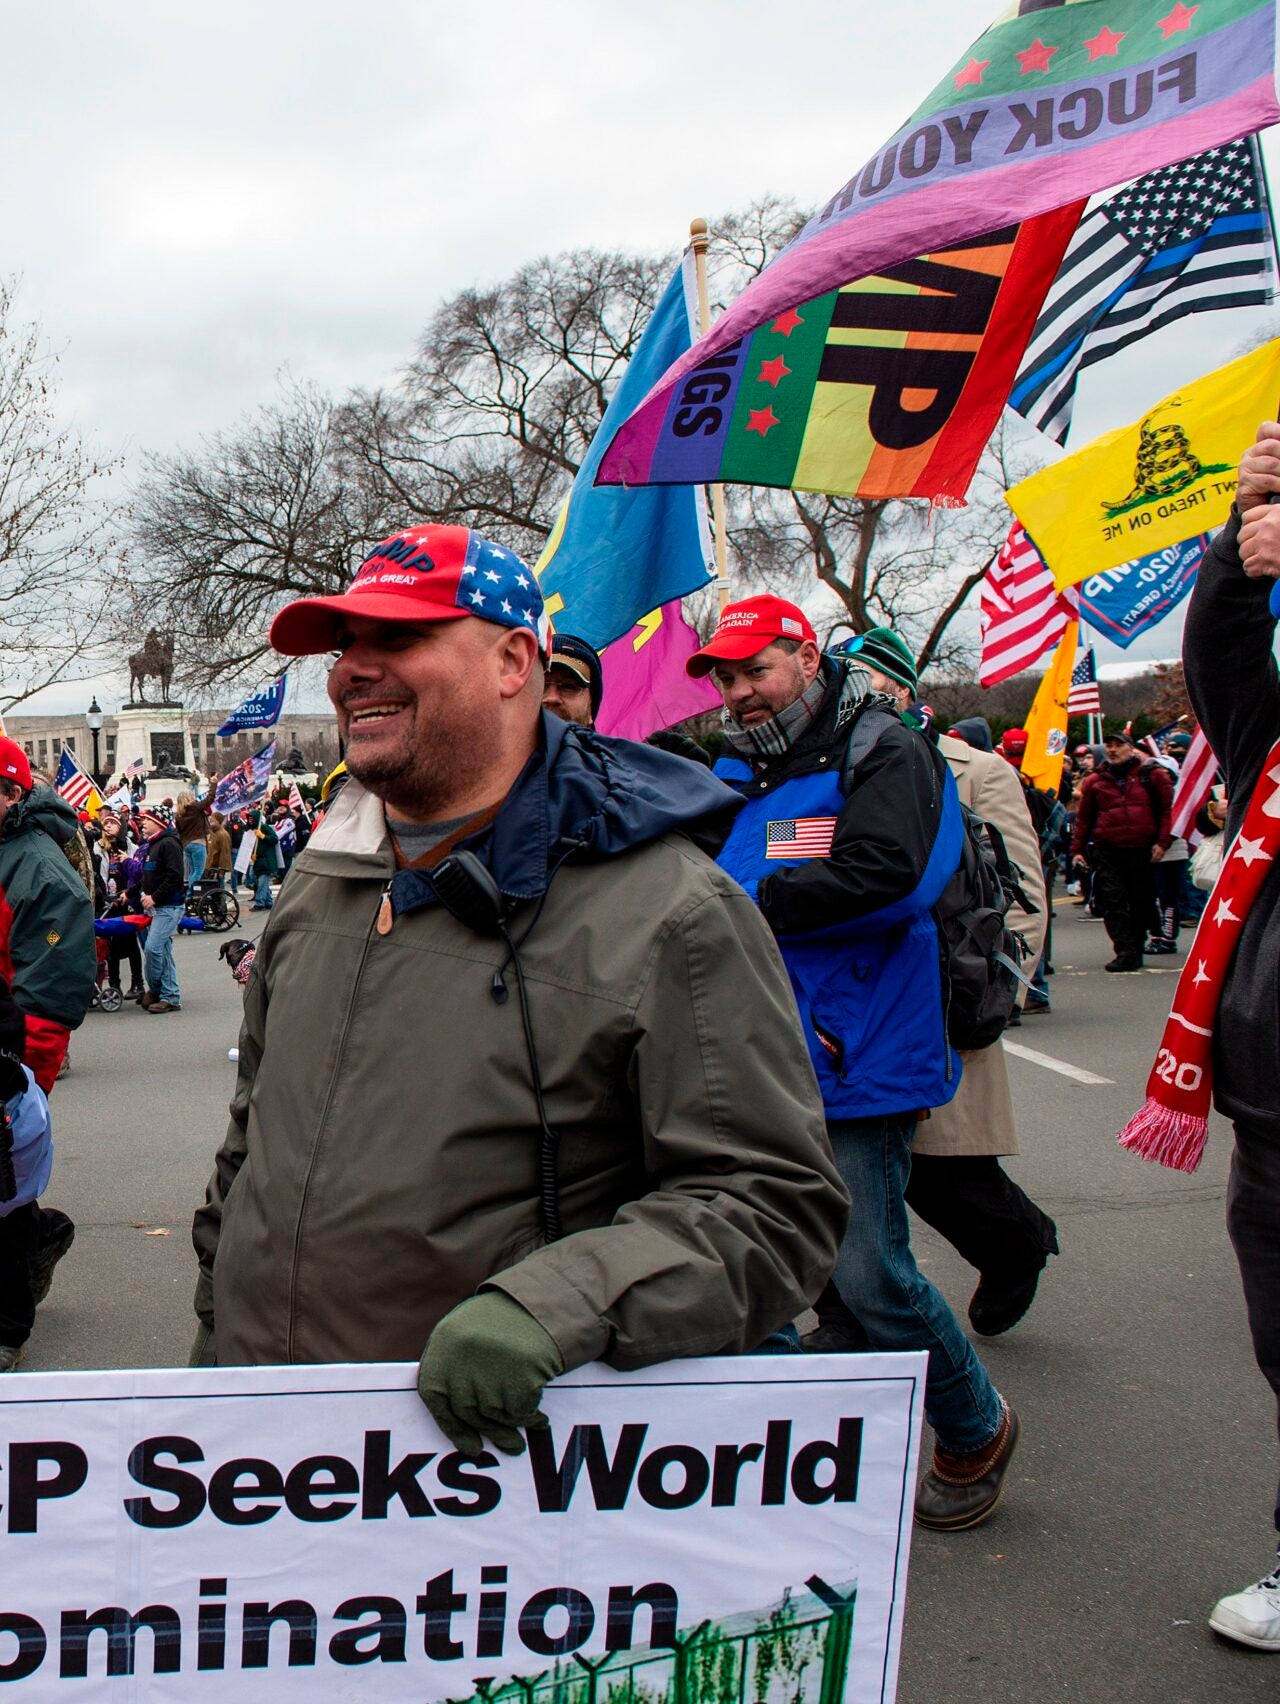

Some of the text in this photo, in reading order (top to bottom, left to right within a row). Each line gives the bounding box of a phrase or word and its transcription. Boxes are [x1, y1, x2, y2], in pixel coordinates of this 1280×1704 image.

[380, 574, 418, 586] GREAT
[725, 619, 753, 629] AGAIN
[123, 1430, 502, 1529] Seeks
[525, 1417, 863, 1513] World
